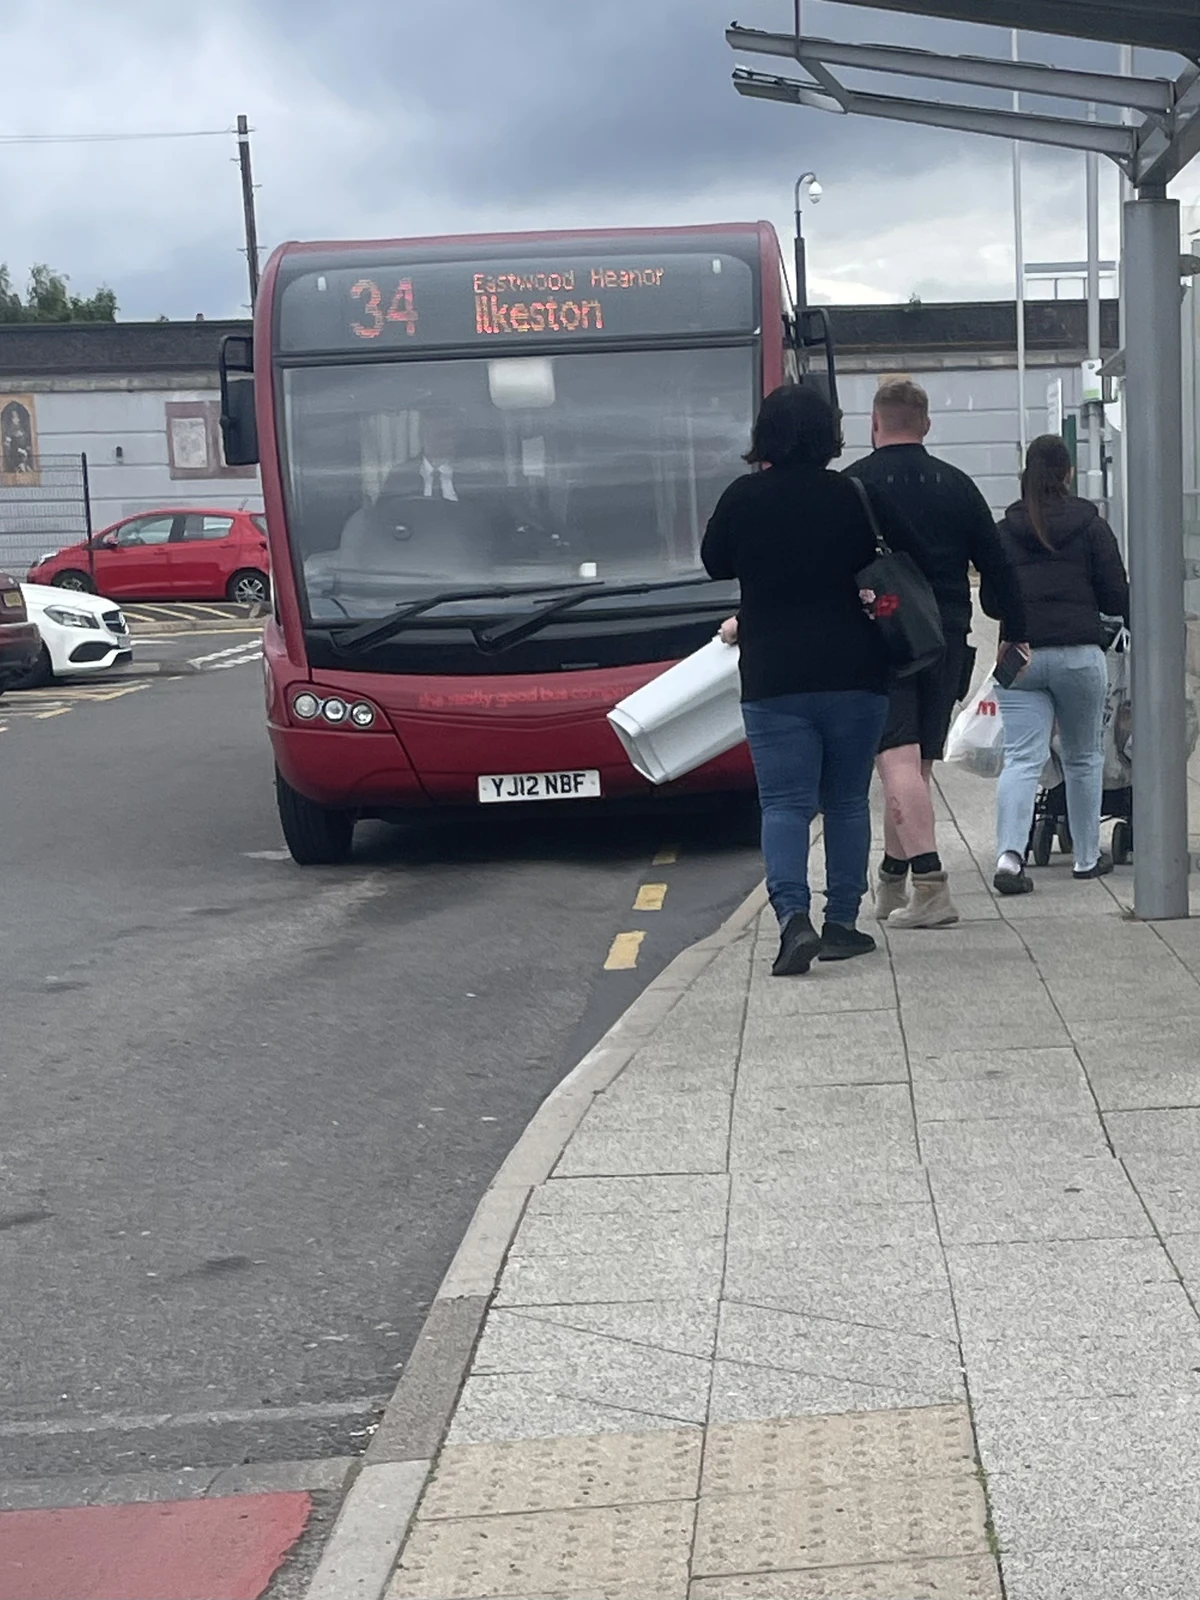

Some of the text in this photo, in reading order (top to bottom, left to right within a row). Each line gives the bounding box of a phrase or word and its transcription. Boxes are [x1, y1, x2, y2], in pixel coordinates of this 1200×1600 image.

[473, 267, 665, 293] Eastwood Heanor
[350, 277, 419, 339] 34
[475, 295, 604, 334] Ilkeston
[493, 685, 538, 708] good
[540, 686, 568, 701] bus
[571, 684, 633, 701] compan
[491, 773, 586, 797] YJ12 NBF
